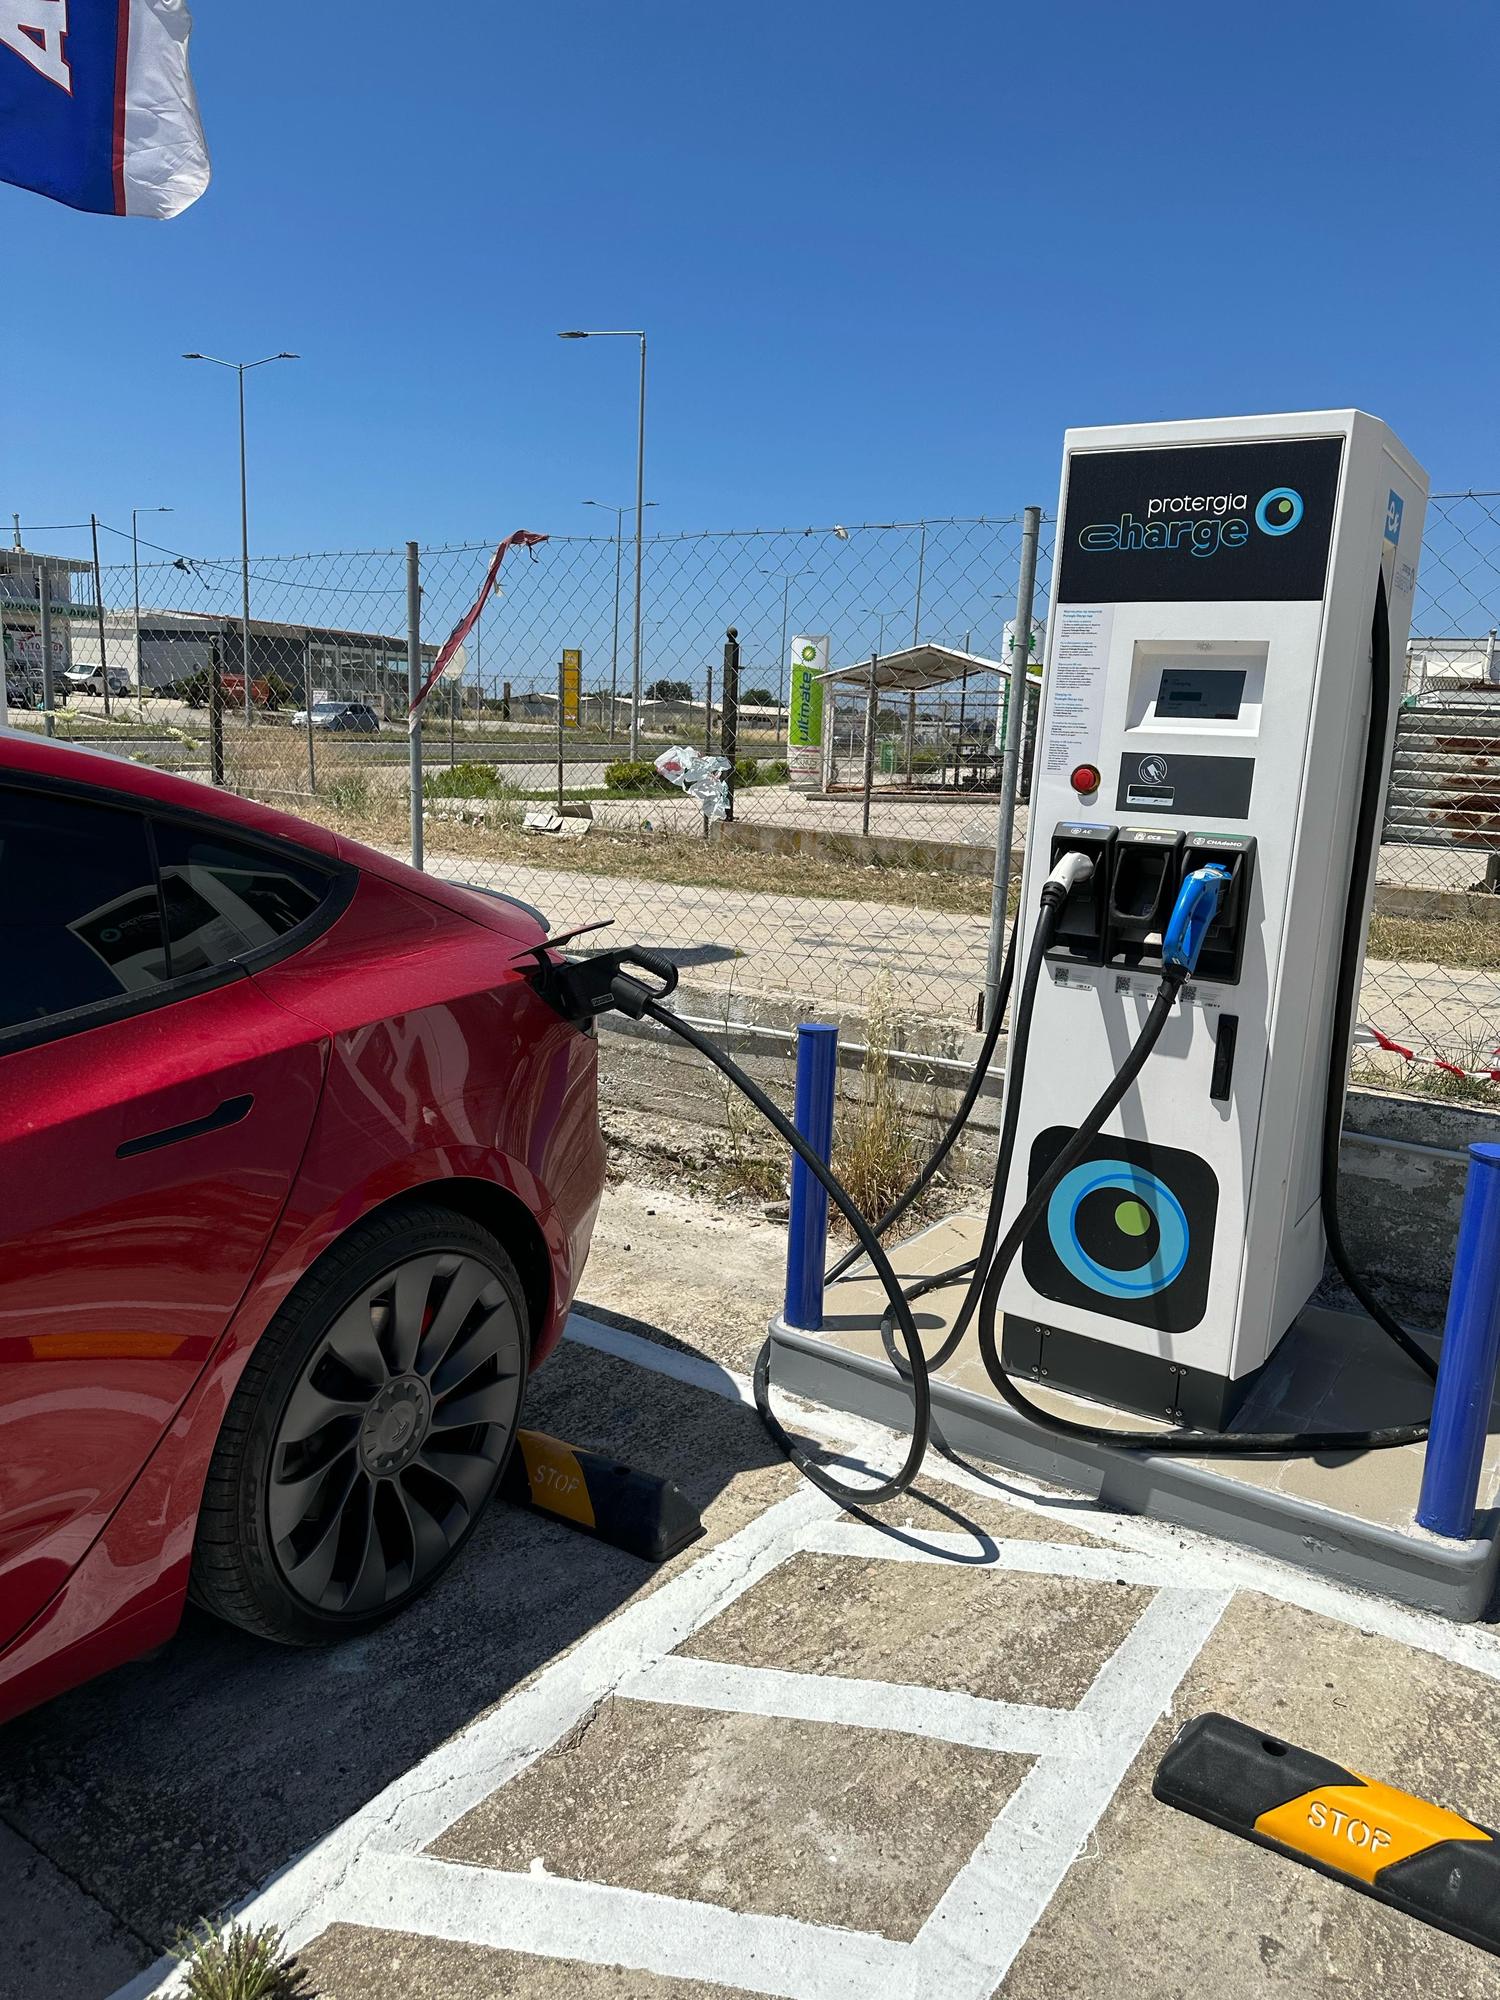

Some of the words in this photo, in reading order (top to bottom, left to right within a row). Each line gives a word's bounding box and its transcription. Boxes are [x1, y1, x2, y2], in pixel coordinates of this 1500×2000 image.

[1079, 514, 1248, 556] charge
[799, 672, 811, 741] ultimate
[535, 1465, 579, 1493] STOP
[1308, 1802, 1391, 1853] STOP
